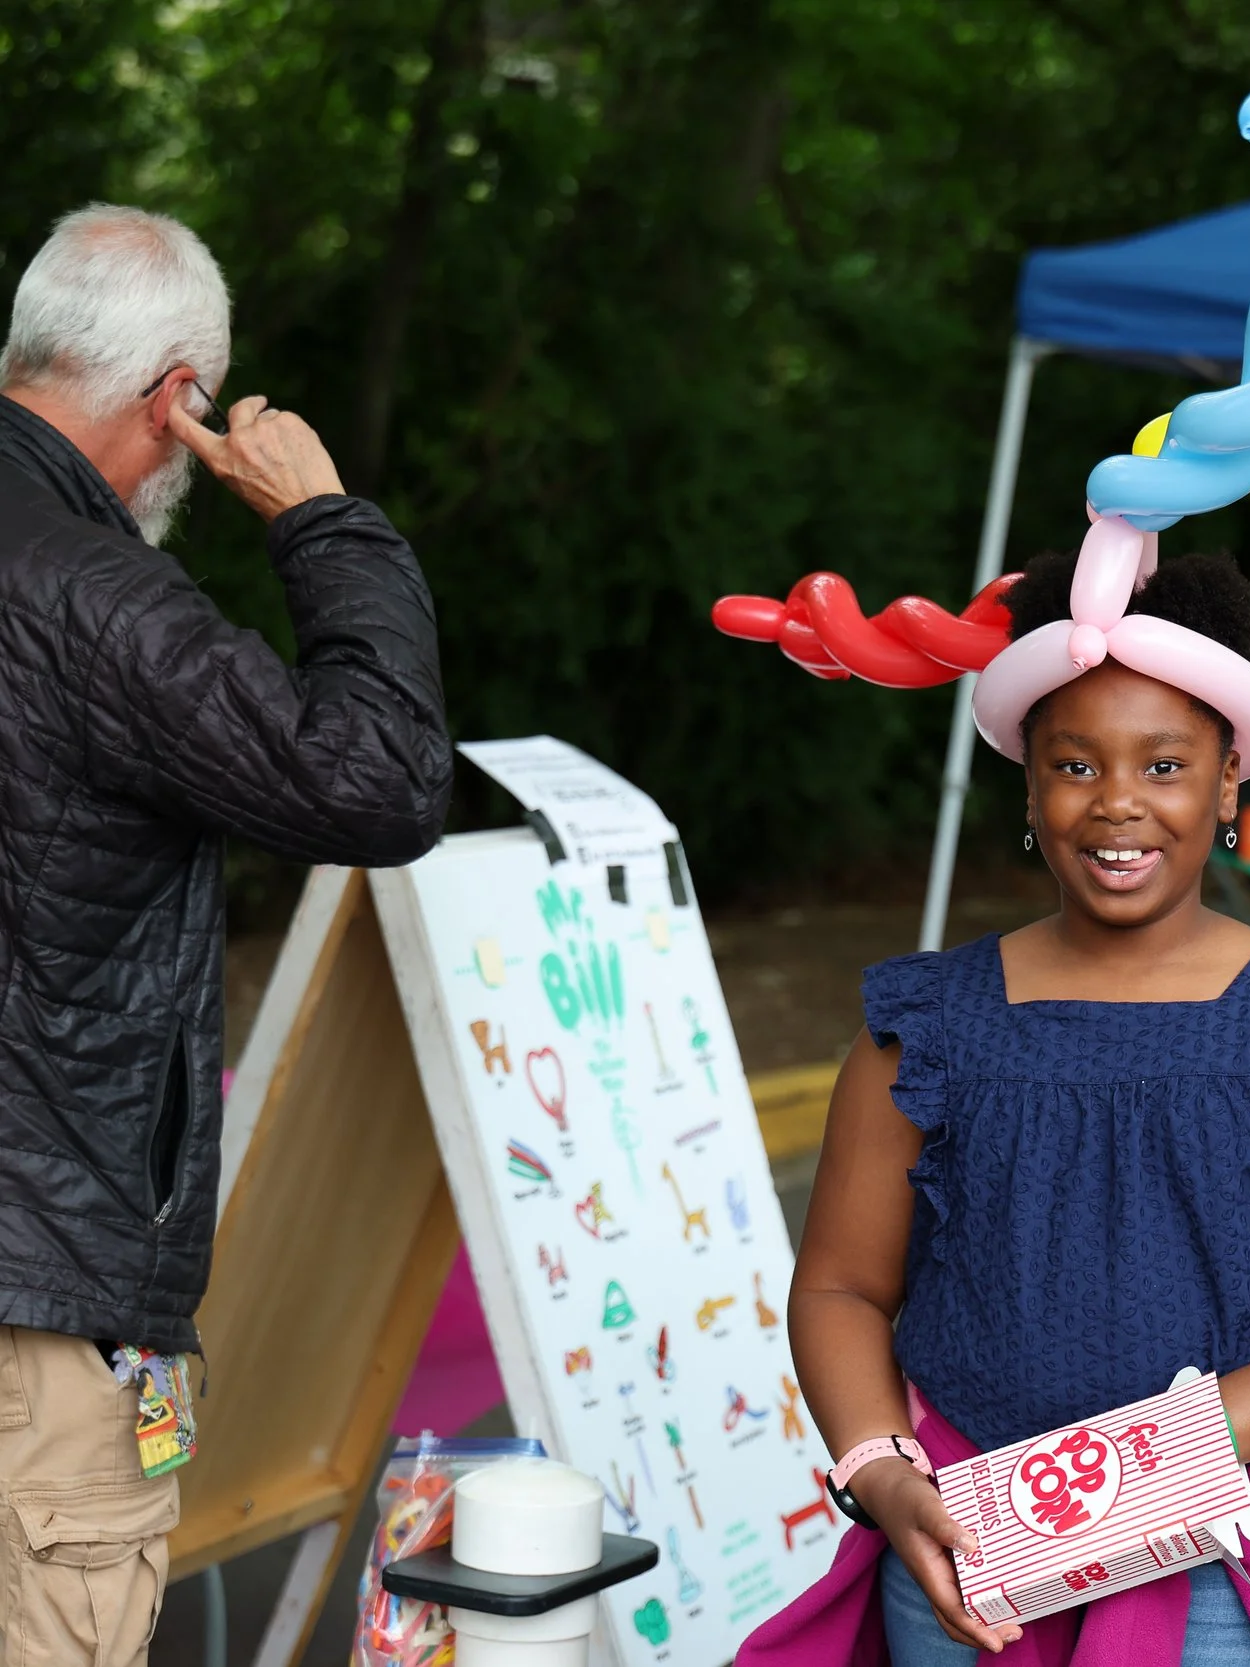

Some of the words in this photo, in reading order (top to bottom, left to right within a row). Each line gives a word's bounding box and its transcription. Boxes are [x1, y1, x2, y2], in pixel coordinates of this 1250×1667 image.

[541, 939, 624, 1031] Bill
[1053, 1430, 1108, 1493] POP
[1116, 1423, 1162, 1473] fresh
[970, 1459, 1002, 1531] DELICIOUS
[1020, 1453, 1091, 1535] CORN
[1061, 1569, 1090, 1593] CORN
[1080, 1561, 1110, 1583] POP
